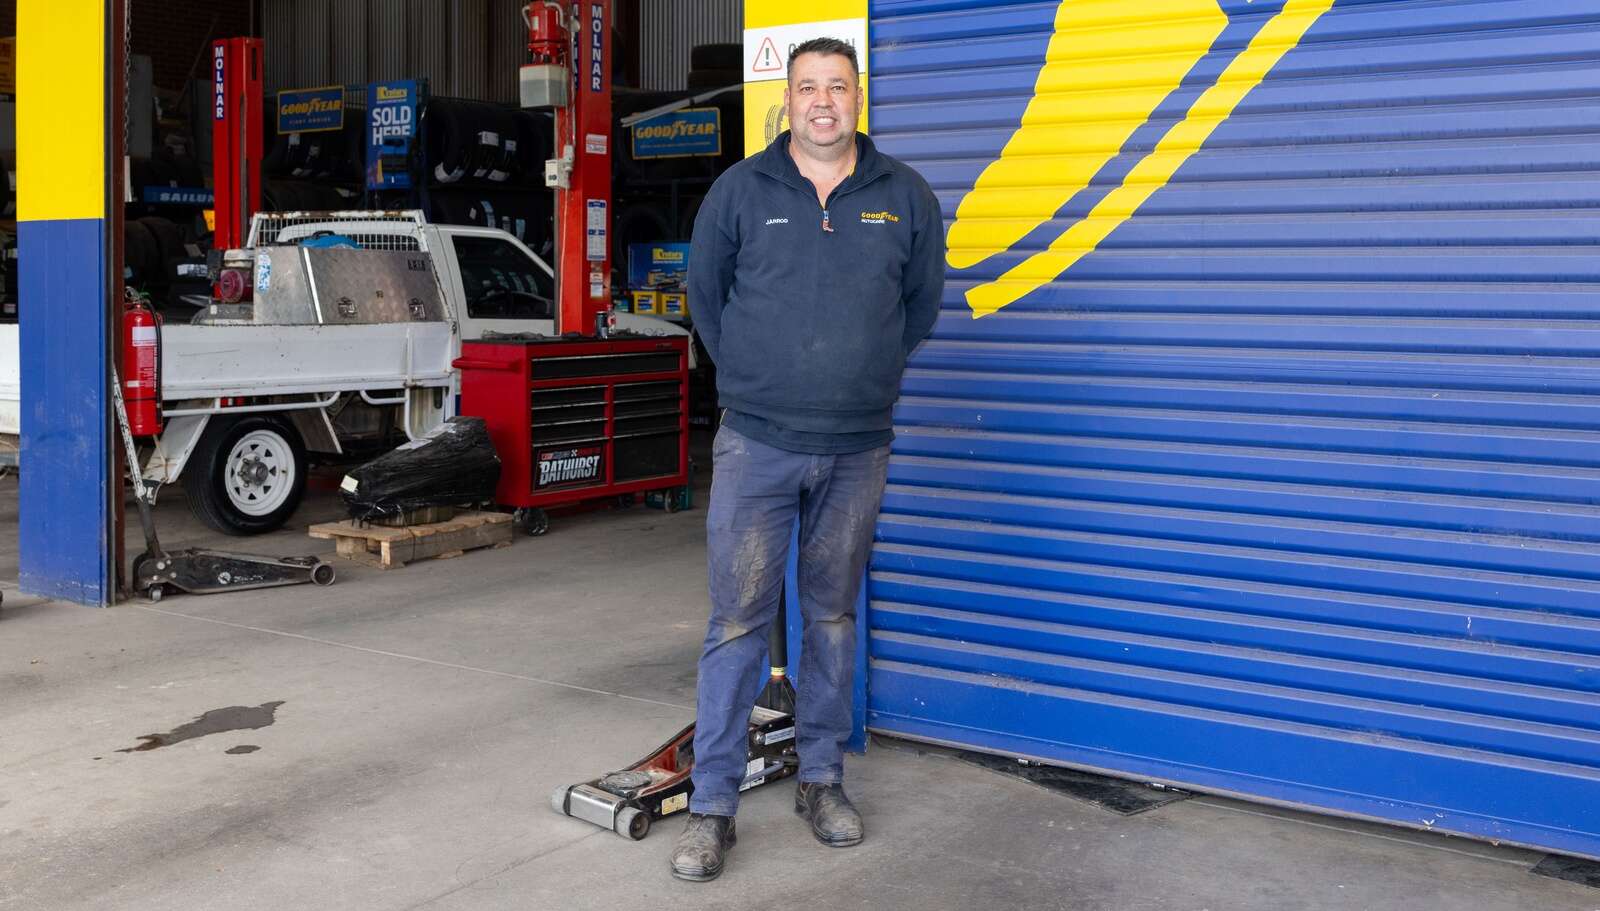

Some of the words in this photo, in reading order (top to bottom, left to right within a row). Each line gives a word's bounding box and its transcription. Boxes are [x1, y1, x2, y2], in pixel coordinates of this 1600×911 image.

[592, 5, 602, 90] MOLNAR
[214, 46, 224, 118] MOLNAR
[281, 98, 342, 116] GOODYEAR
[372, 106, 412, 126] SOLD
[372, 125, 411, 146] HERE
[636, 120, 715, 140] GOODYEAR
[861, 211, 899, 223] GOODYEAR
[539, 455, 600, 486] BATHURST
